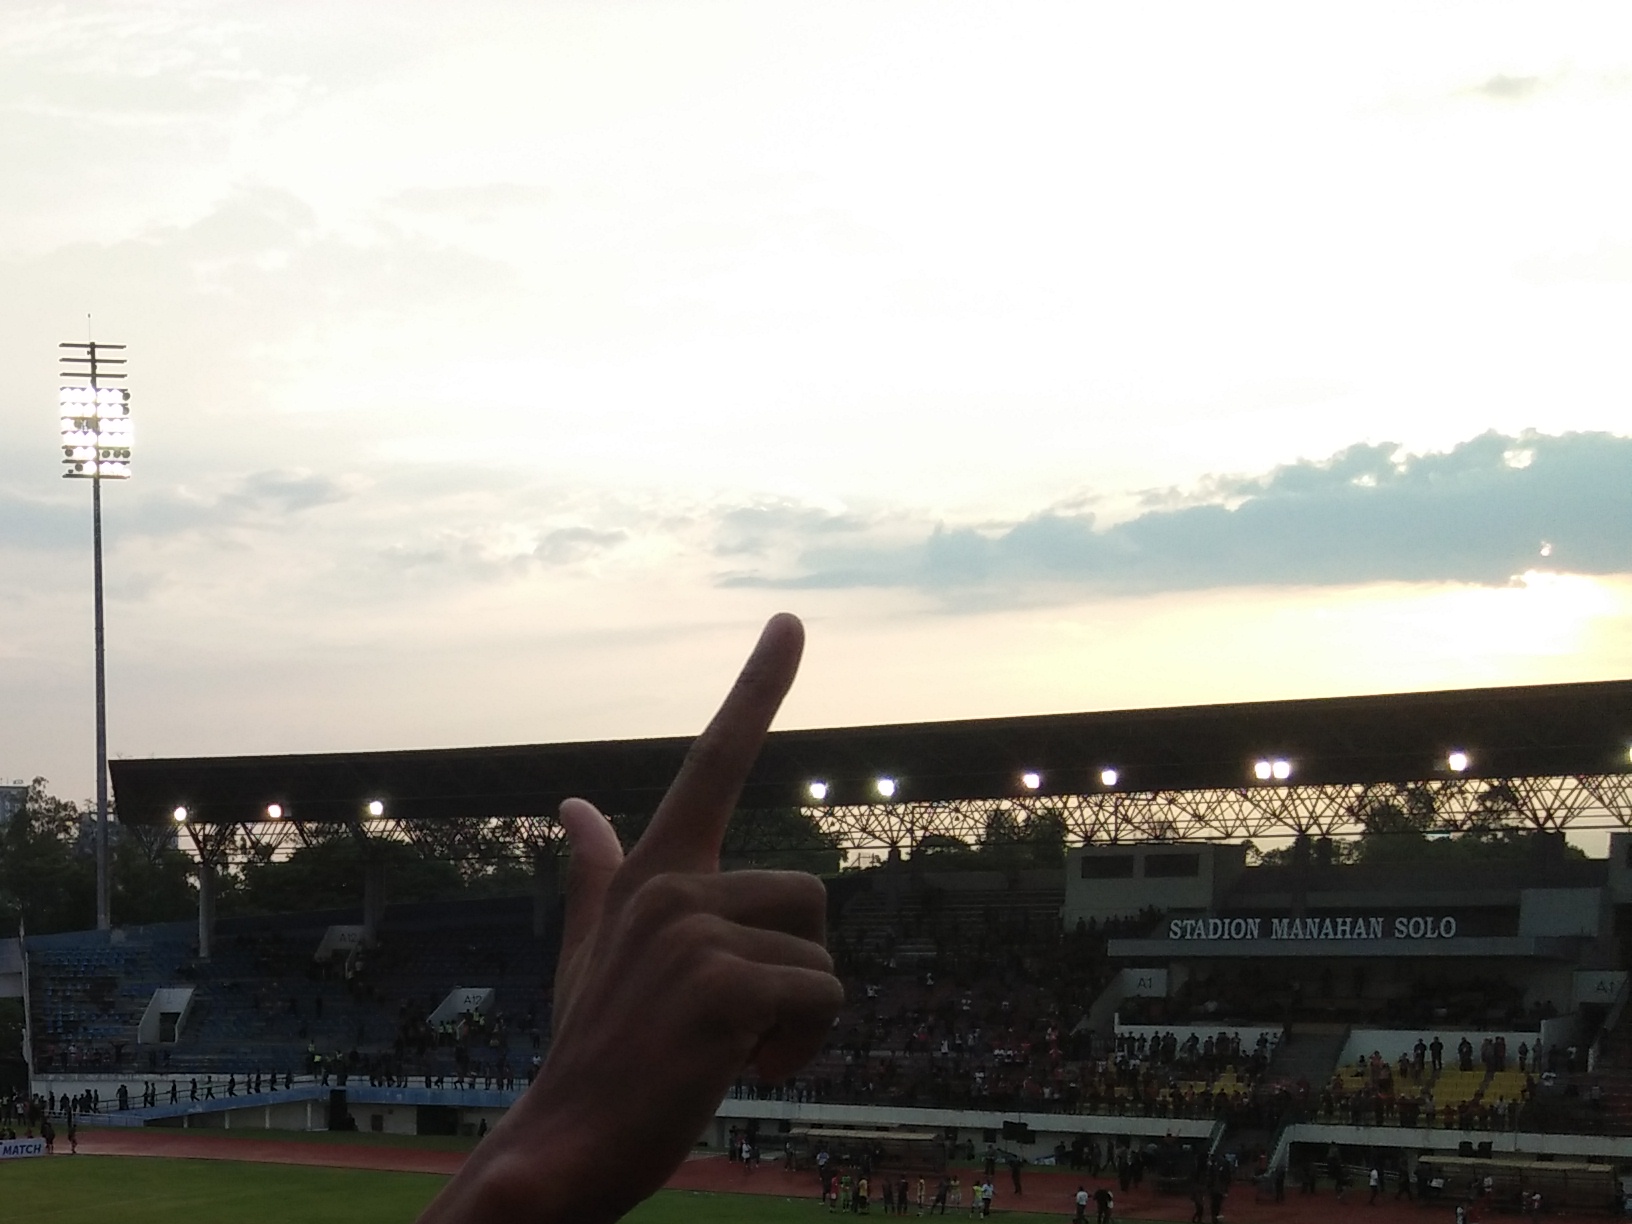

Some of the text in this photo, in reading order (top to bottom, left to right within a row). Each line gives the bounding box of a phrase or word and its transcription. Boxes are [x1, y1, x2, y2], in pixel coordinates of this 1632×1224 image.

[1168, 916, 1457, 940] STADION MANAHAN SOLO
[4, 1142, 43, 1157] MATCH
